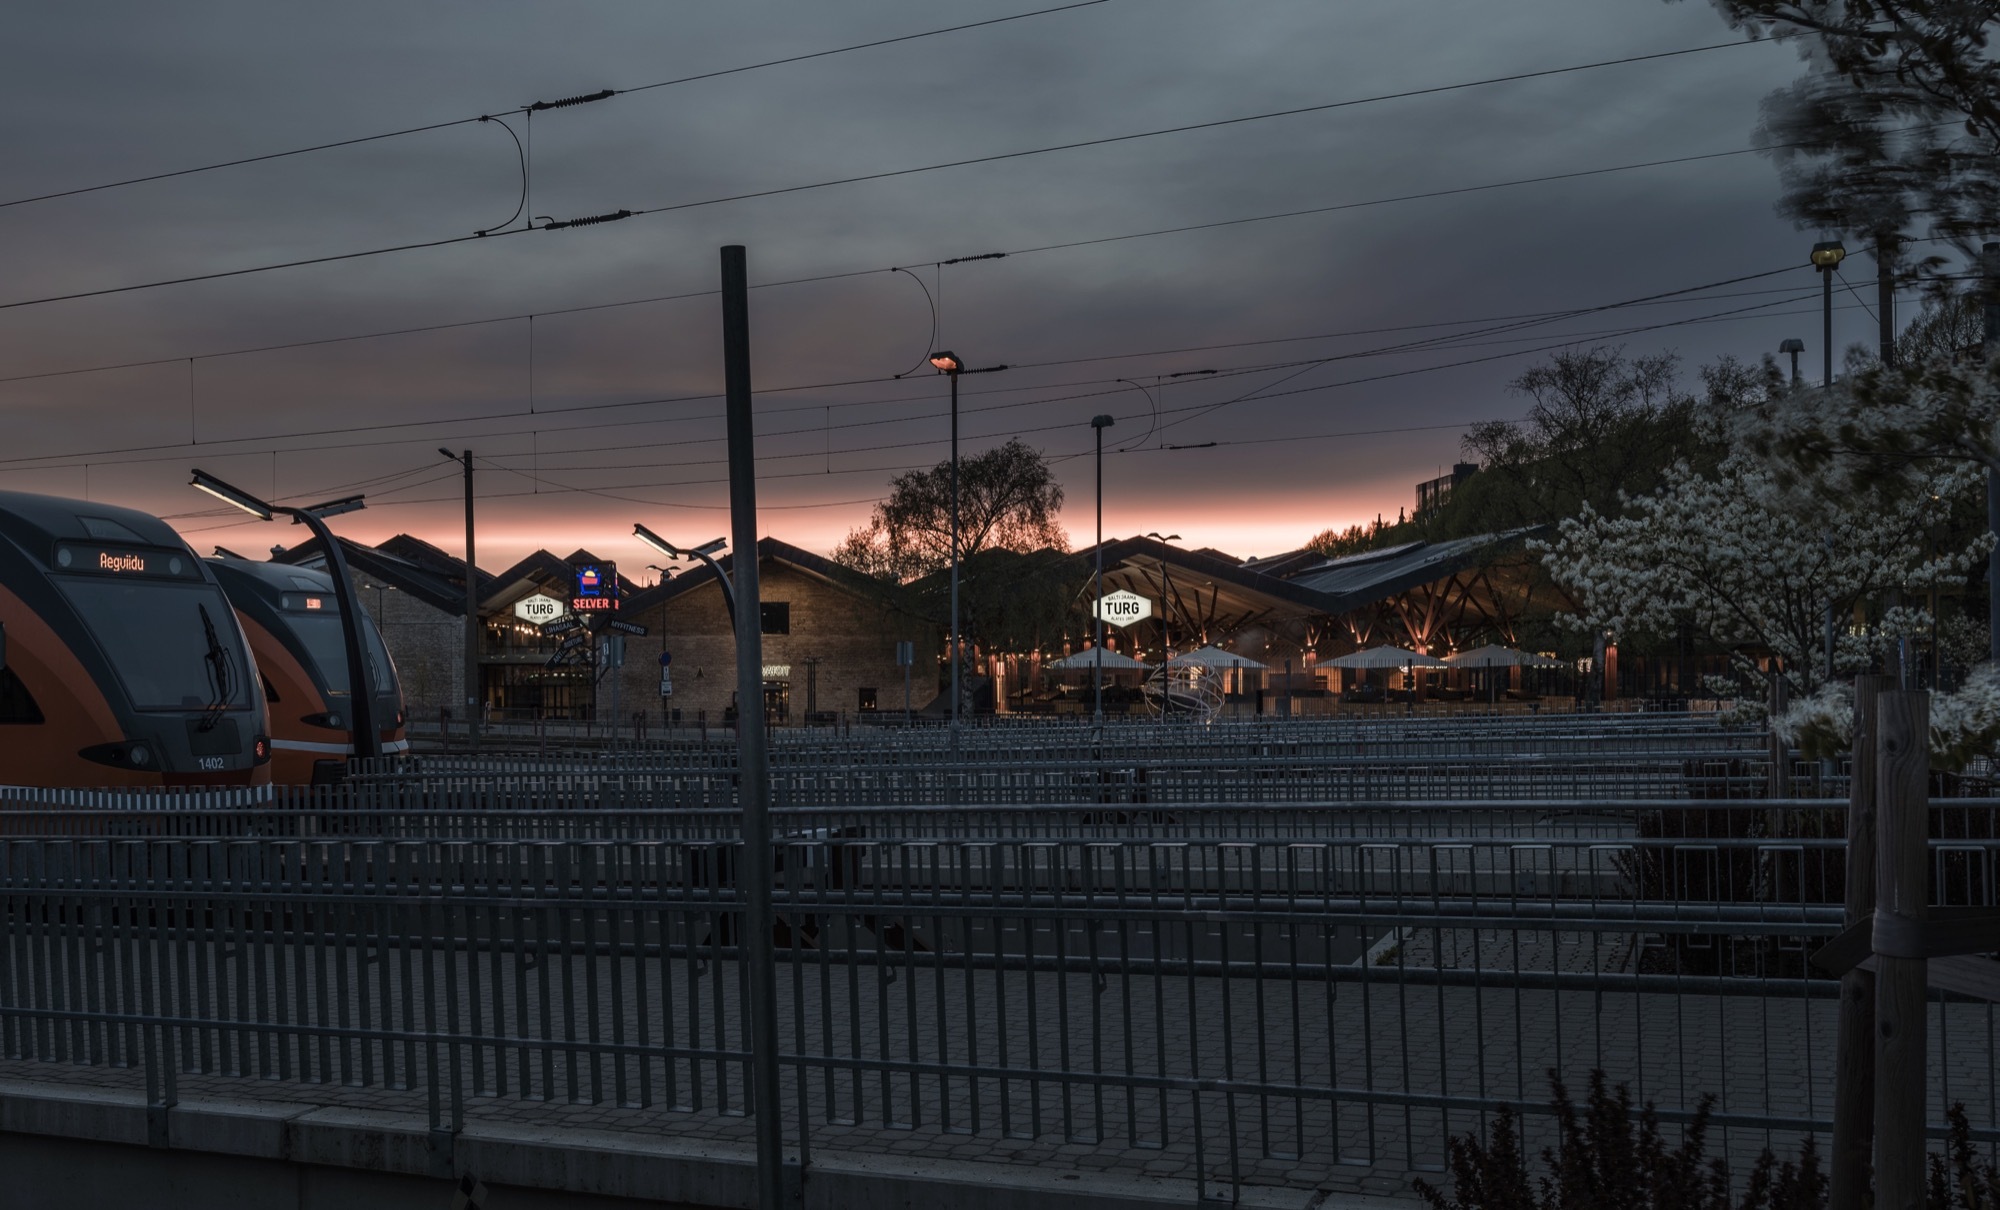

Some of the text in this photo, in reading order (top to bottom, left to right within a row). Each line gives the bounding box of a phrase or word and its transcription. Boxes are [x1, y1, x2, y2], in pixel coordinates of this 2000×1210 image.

[100, 552, 144, 572] Aegviidu
[573, 598, 609, 609] SELVER
[1107, 594, 1121, 602] BALTI
[525, 604, 553, 615] TURG
[1105, 602, 1139, 615] TURG
[610, 620, 645, 635] MYFITNESS
[198, 757, 225, 770] 1402
